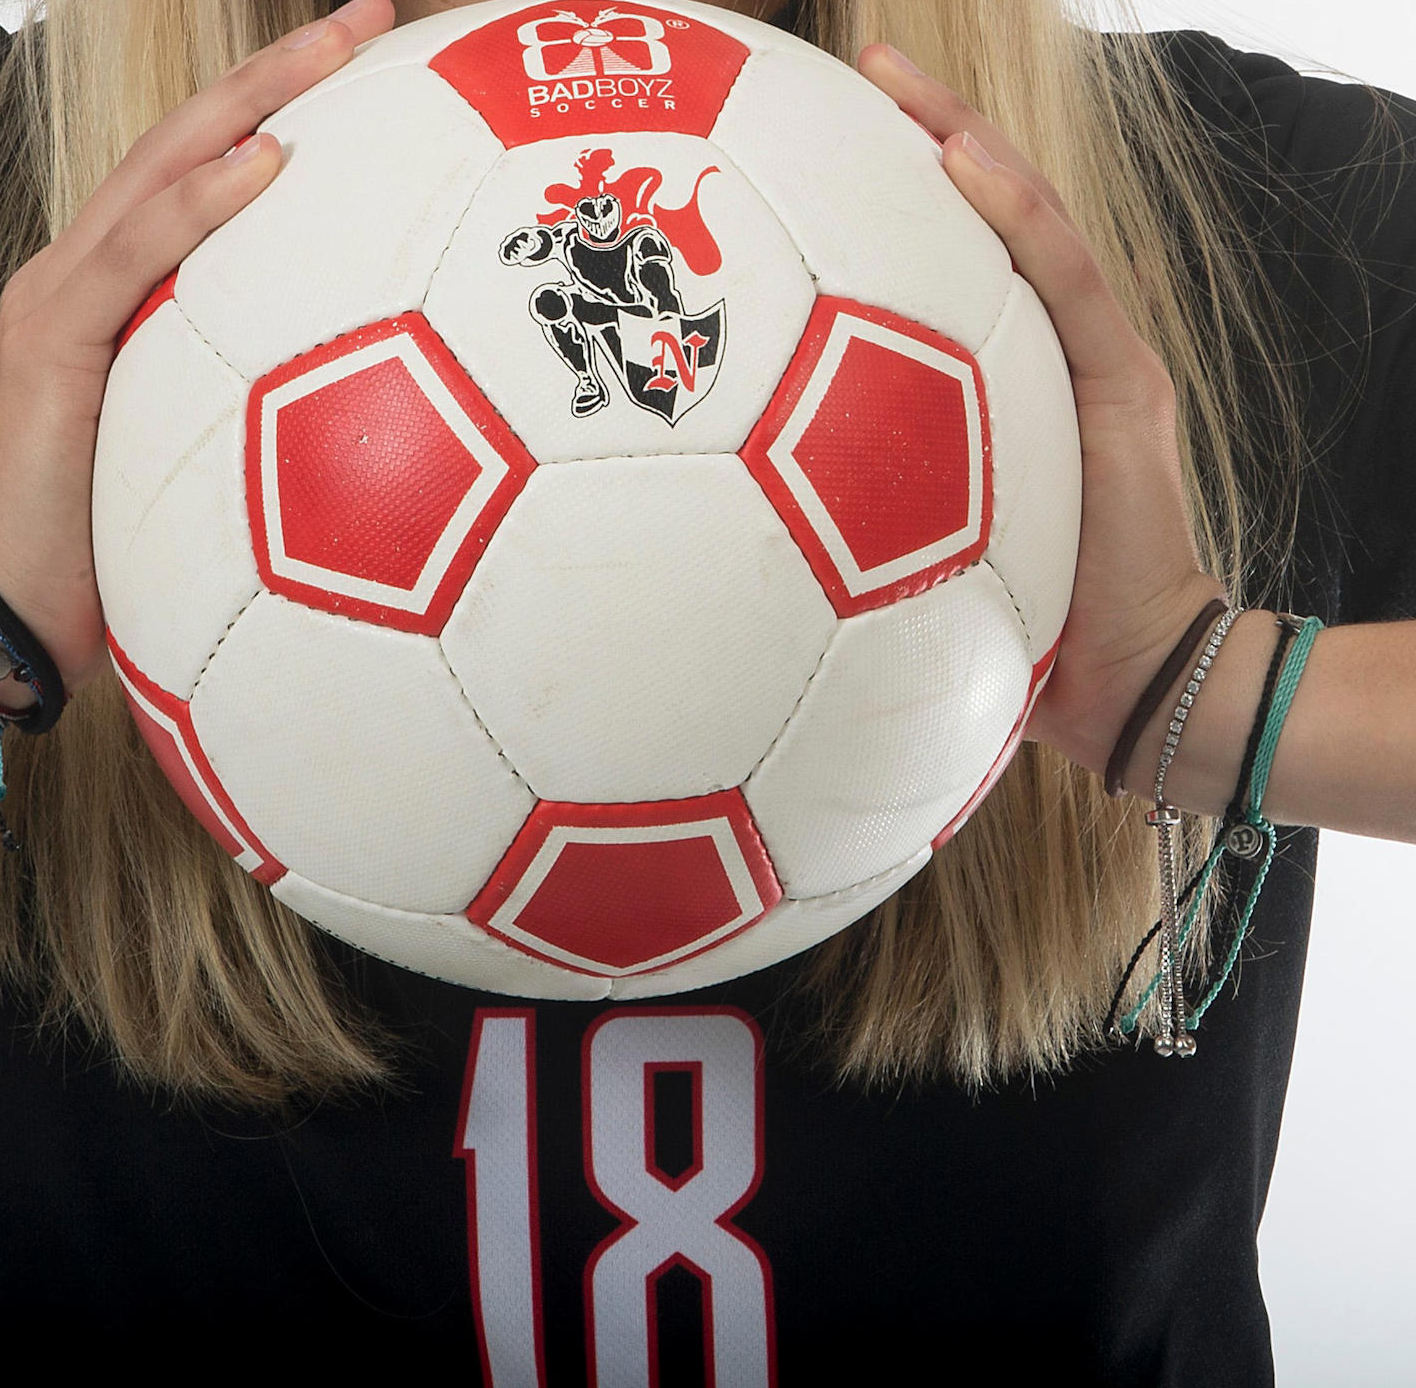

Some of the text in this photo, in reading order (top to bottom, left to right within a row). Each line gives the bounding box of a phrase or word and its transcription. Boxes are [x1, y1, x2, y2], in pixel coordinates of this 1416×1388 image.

[528, 78, 675, 106] BADBOYZ
[530, 98, 676, 118] SOCCER
[643, 330, 711, 393] N
[452, 1005, 779, 1388] 18
